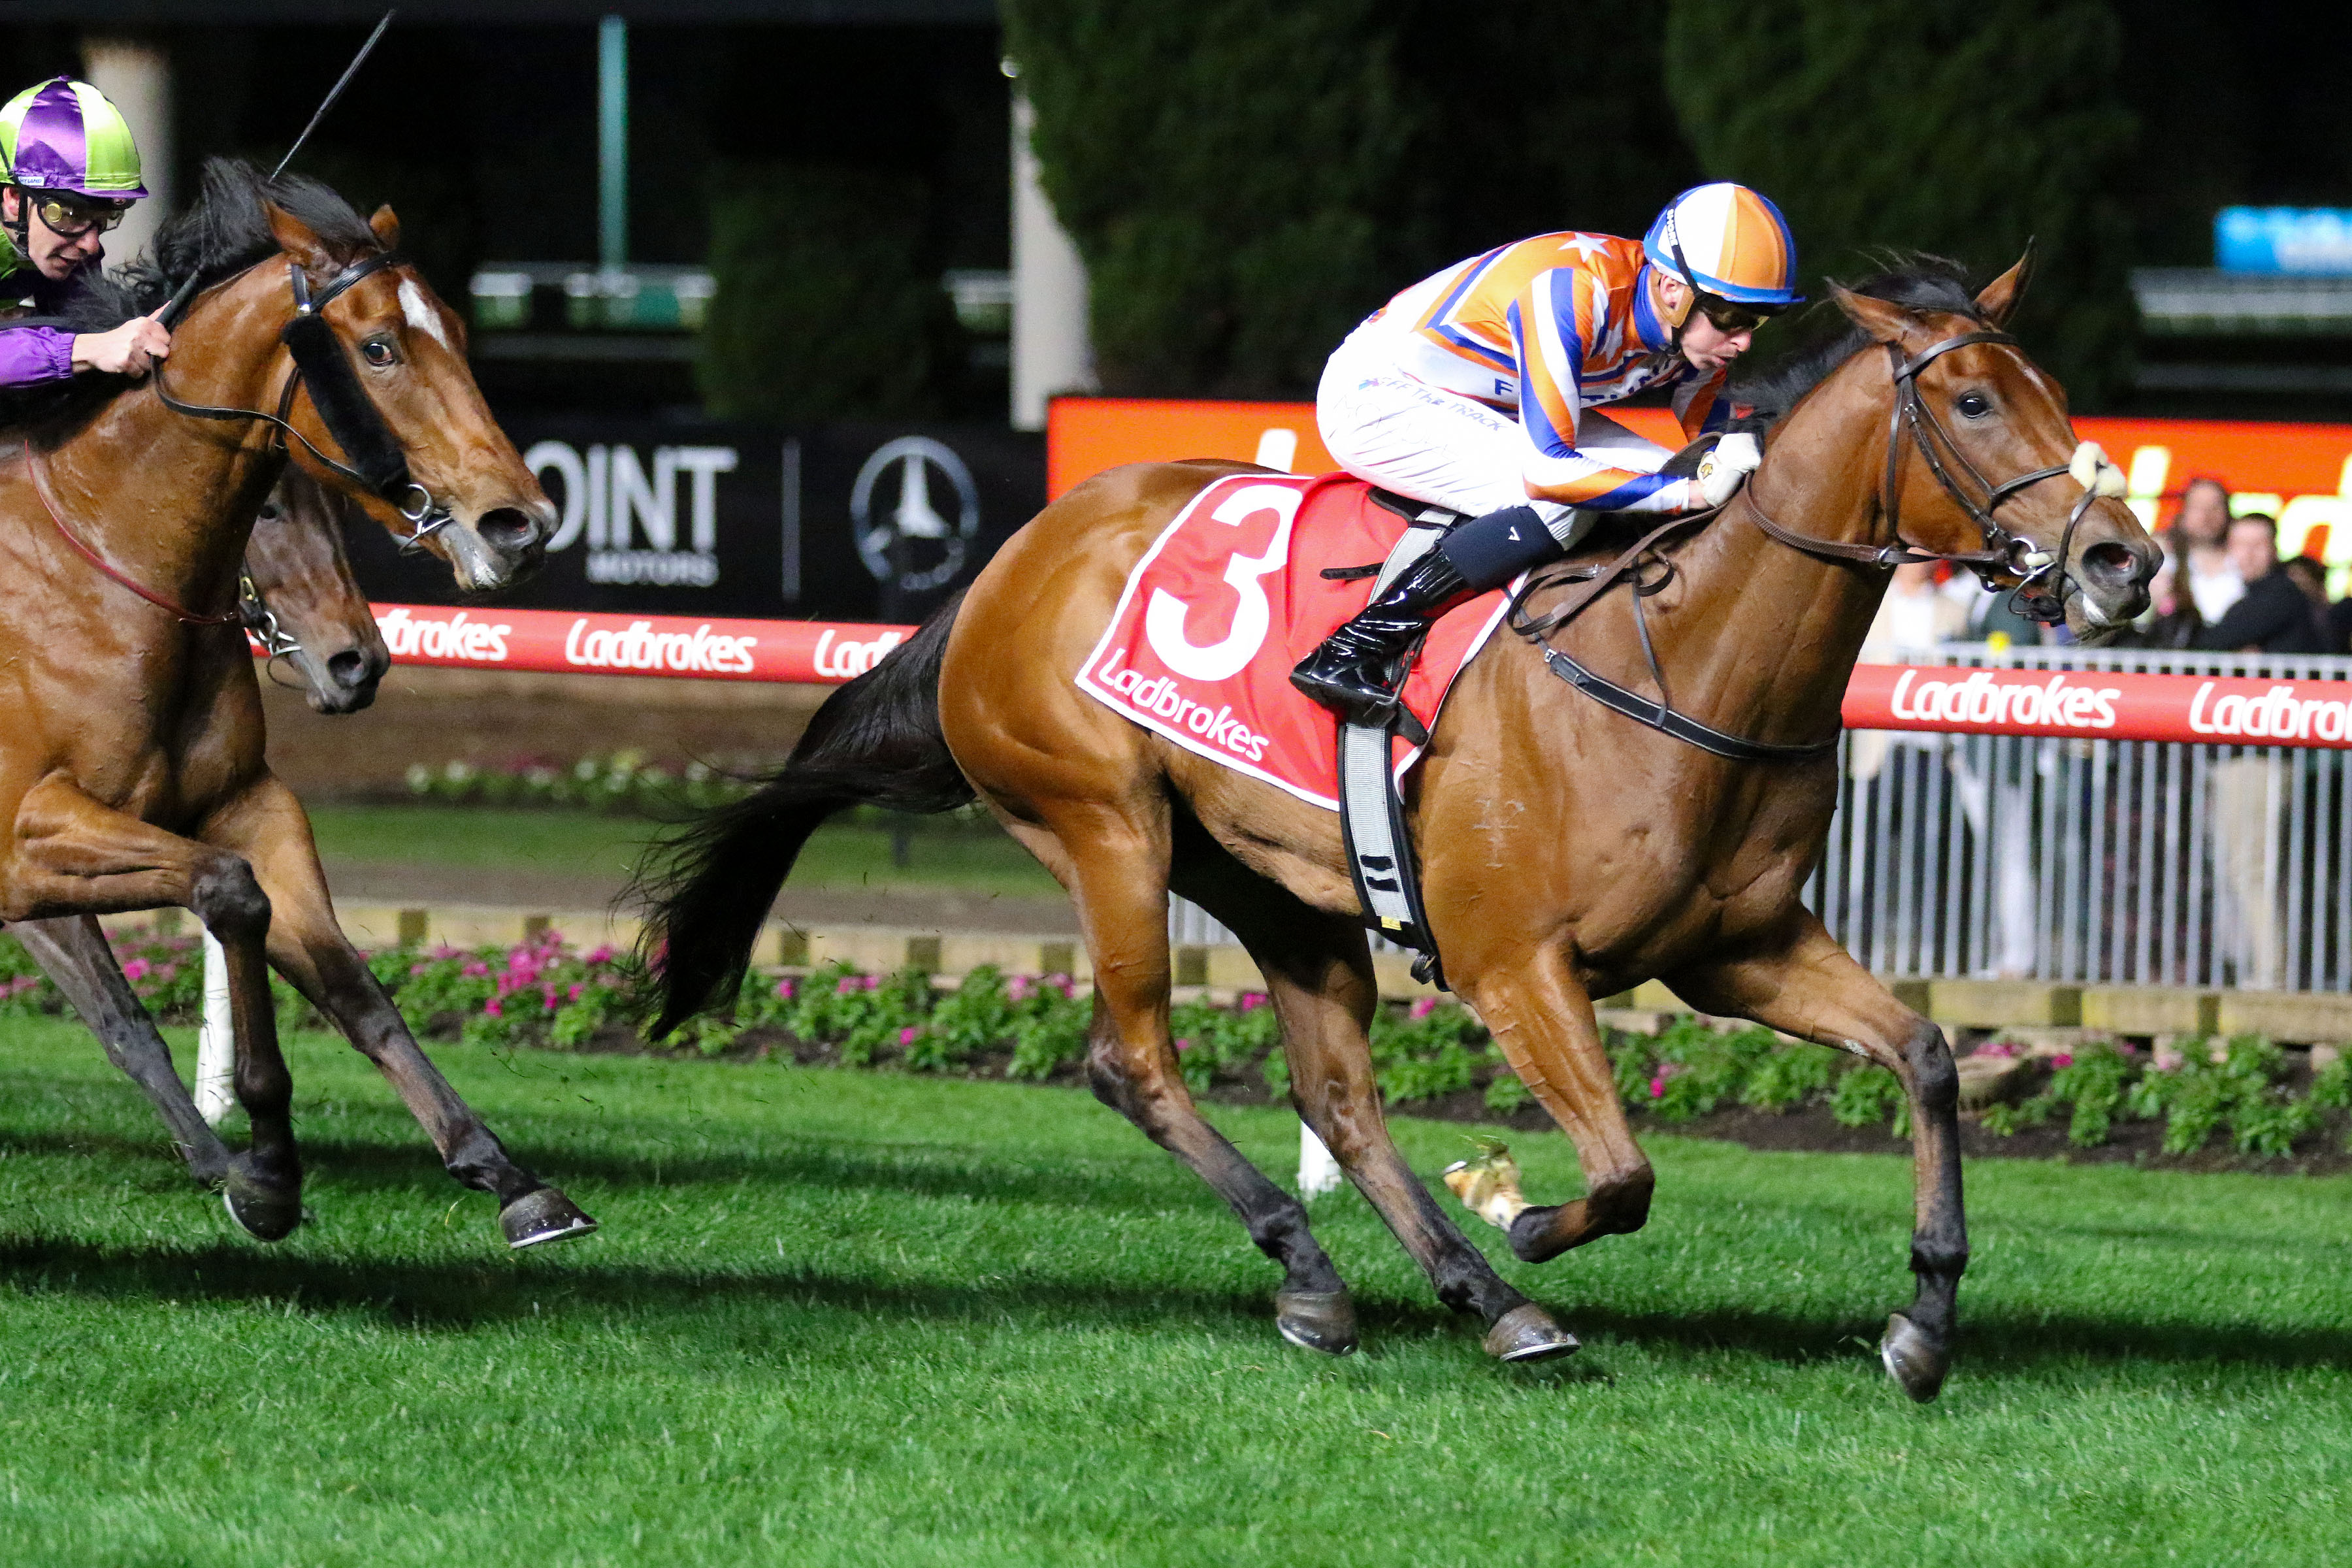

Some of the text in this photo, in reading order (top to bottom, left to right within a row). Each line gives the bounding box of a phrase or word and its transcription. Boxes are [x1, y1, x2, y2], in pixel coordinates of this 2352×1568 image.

[524, 440, 739, 553] OINT
[587, 551, 719, 587] MOTORS
[1146, 484, 1303, 681] 3
[376, 608, 512, 661] dbrokes
[565, 618, 759, 673] Ladbrokes
[1098, 648, 1269, 762] Ladbrokes
[1890, 669, 2352, 742] Ladbrokes Ladbro
